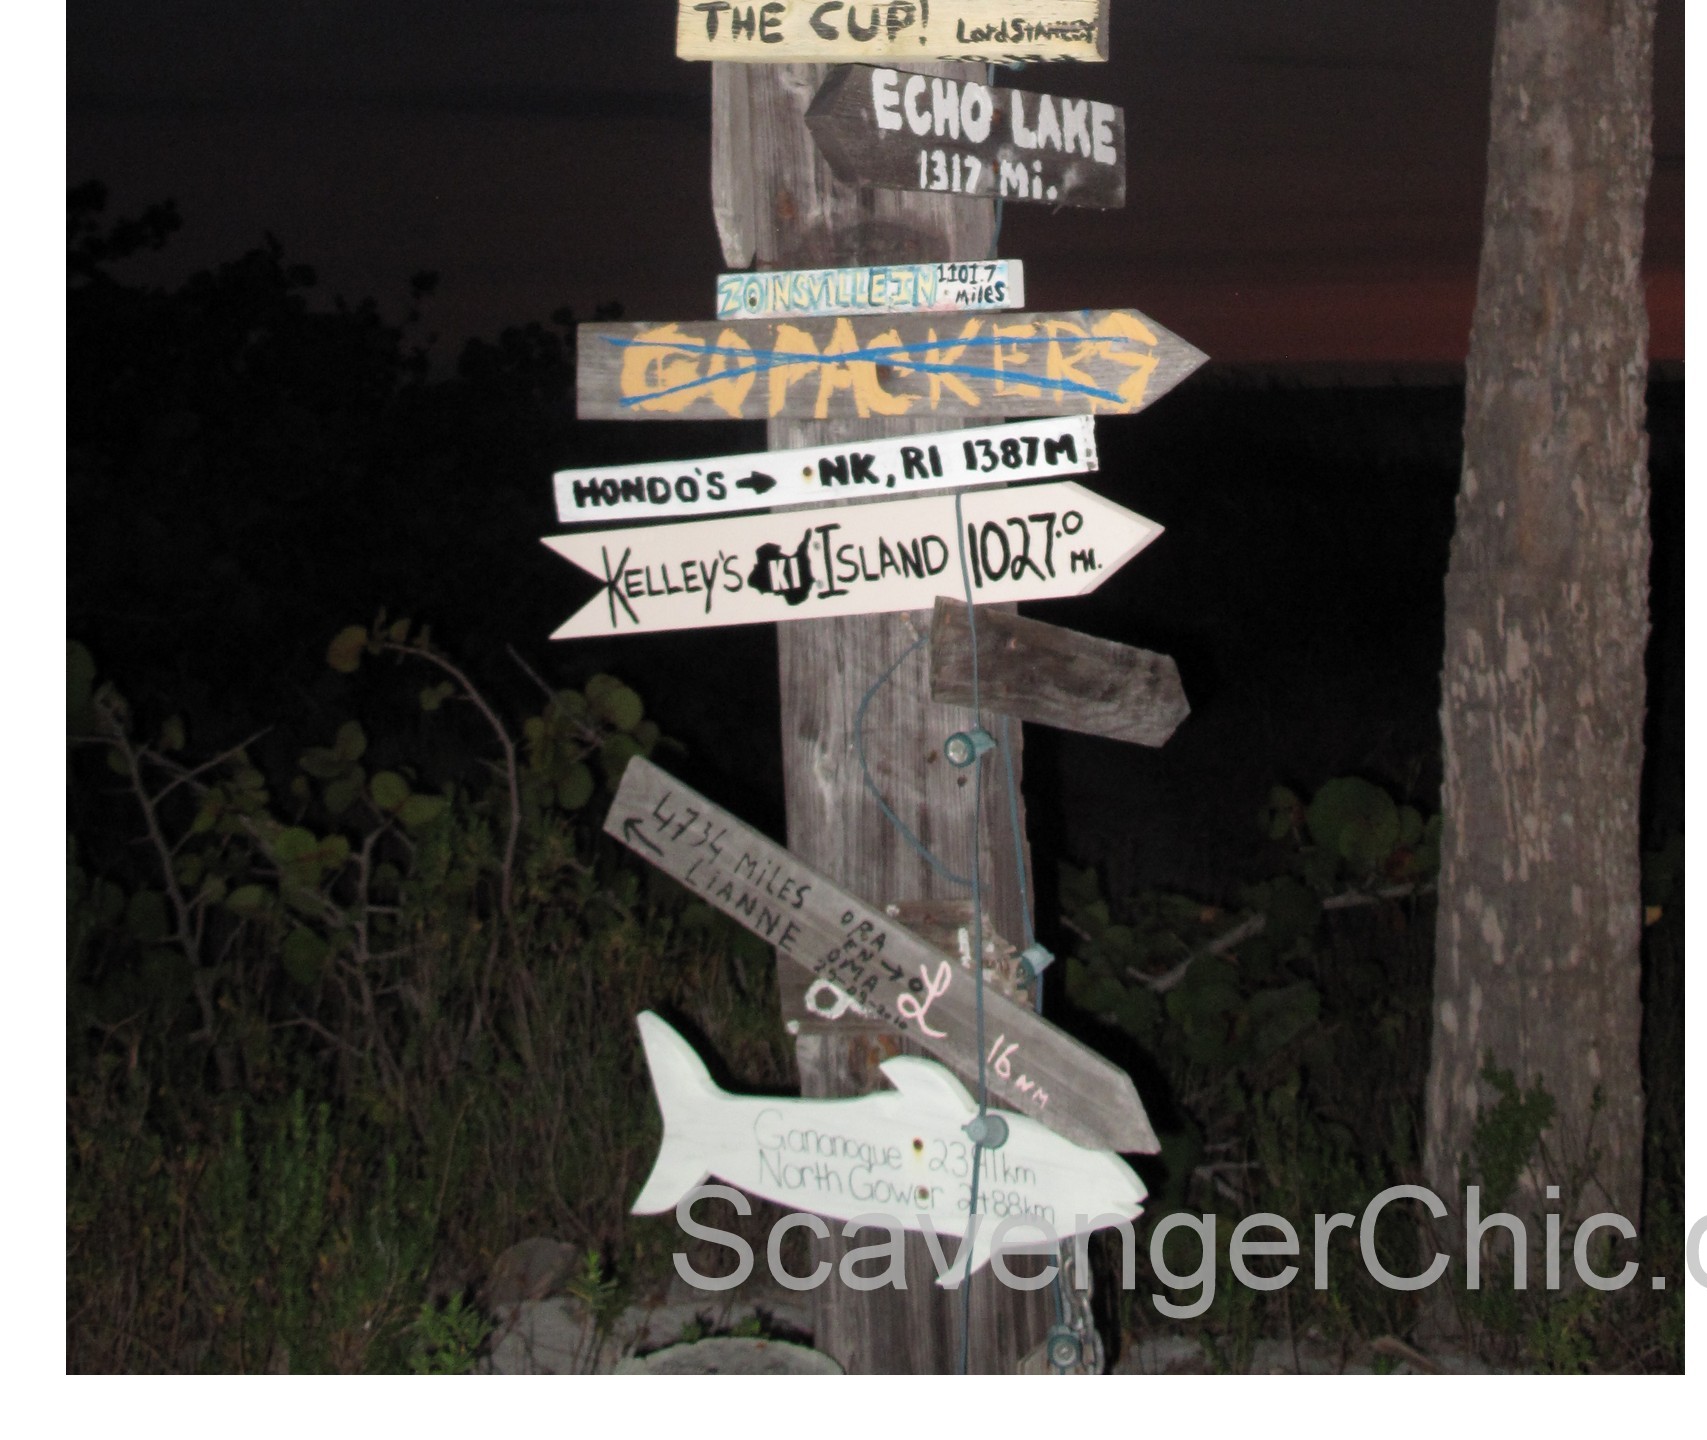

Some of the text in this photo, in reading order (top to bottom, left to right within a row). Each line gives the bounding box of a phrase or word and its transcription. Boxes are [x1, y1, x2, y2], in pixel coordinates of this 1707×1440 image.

[693, 0, 787, 43] THE
[871, 68, 1117, 165] ECHO LAKE
[919, 150, 981, 192] 1317
[620, 312, 1160, 418] GO PACKERS
[572, 468, 728, 507] HONDO'S
[901, 443, 942, 478] RI
[815, 524, 950, 599] ISLAND
[651, 791, 726, 863] 4734
[758, 1150, 843, 1193] North
